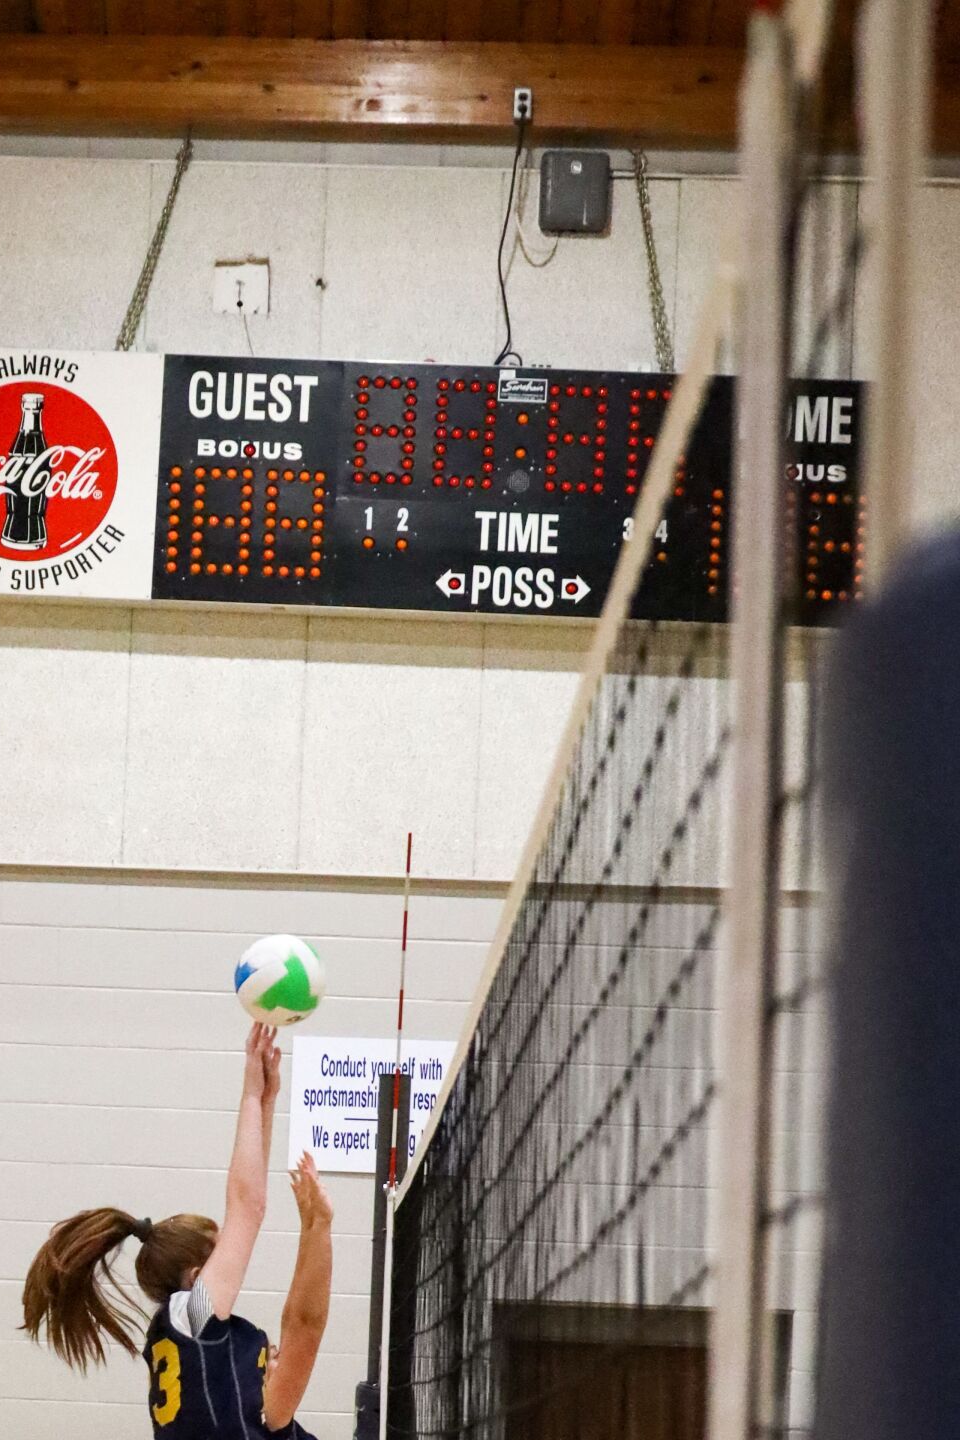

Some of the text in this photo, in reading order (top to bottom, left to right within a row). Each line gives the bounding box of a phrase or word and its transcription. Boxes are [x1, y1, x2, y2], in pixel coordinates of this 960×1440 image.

[189, 370, 319, 423] GUEST
[791, 395, 853, 444] ME
[197, 439, 303, 461] BONUS
[364, 507, 409, 531] 1 2
[474, 511, 559, 554] TIME
[622, 517, 668, 543] 3 4
[10, 523, 125, 590] SUPPORTER
[470, 565, 555, 609] POSS
[321, 1054, 443, 1084] Conduct yourelf with
[304, 1086, 437, 1112] sportsmanshi resp
[312, 1125, 329, 1148] We
[334, 1129, 370, 1155] expect
[151, 1337, 181, 1427] 3
